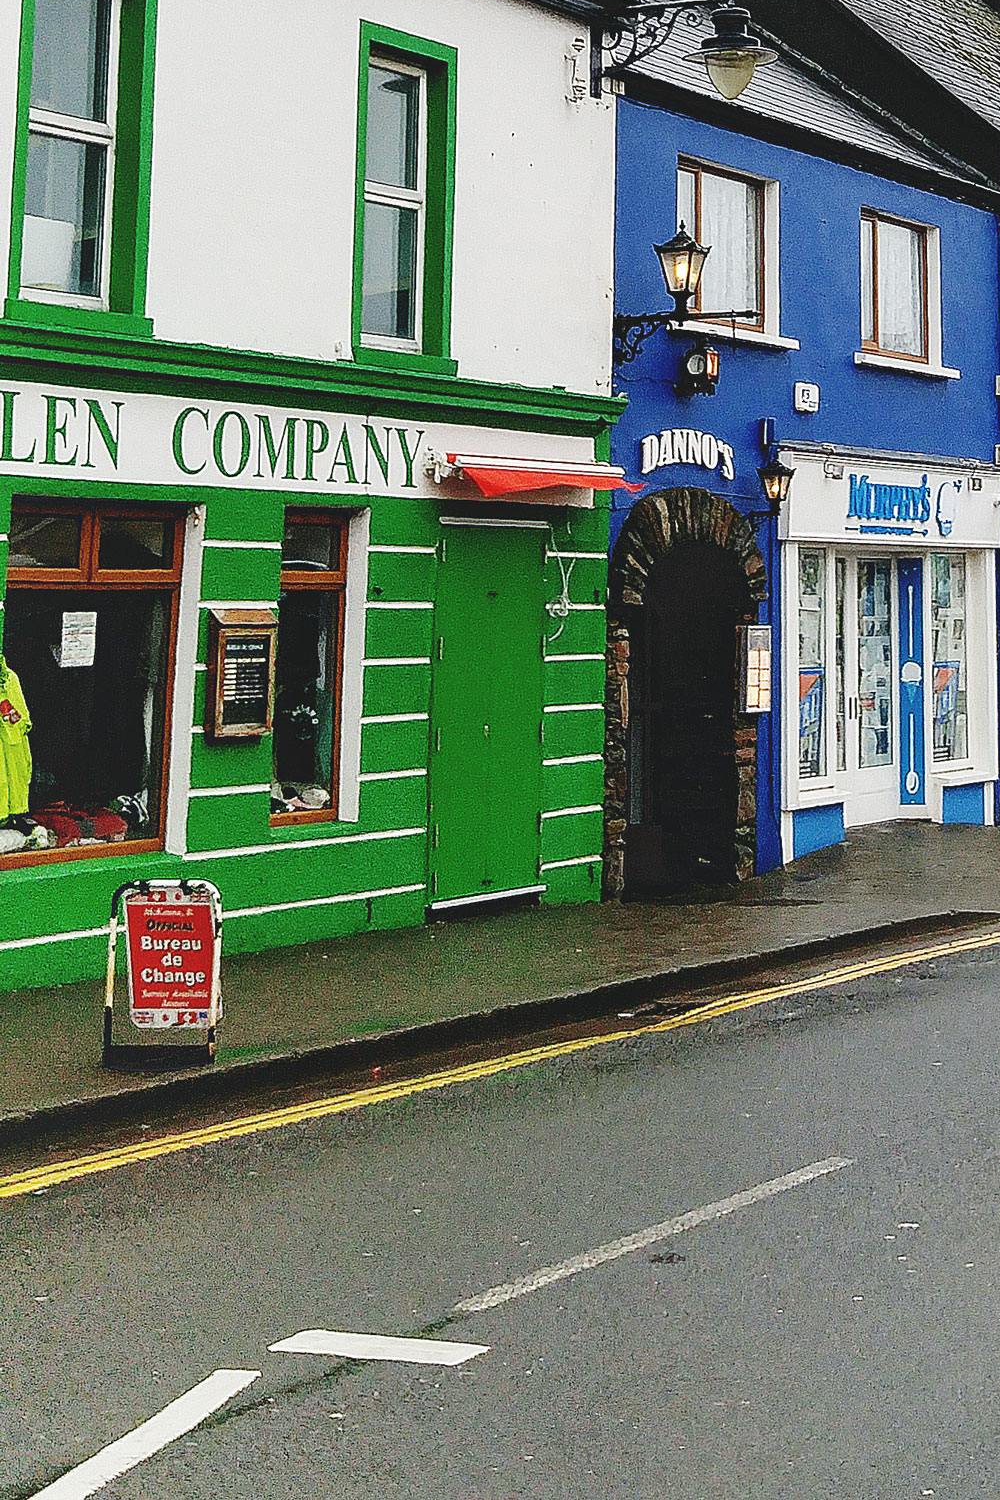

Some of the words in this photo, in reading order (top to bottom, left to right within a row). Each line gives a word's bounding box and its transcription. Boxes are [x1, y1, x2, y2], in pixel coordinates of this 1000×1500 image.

[172, 407, 426, 488] COMPANY
[640, 428, 735, 481] DANNO'S
[846, 473, 931, 523] MURPHY'S
[140, 936, 202, 951] Bureau
[161, 953, 182, 967] de
[140, 968, 206, 986] Change
